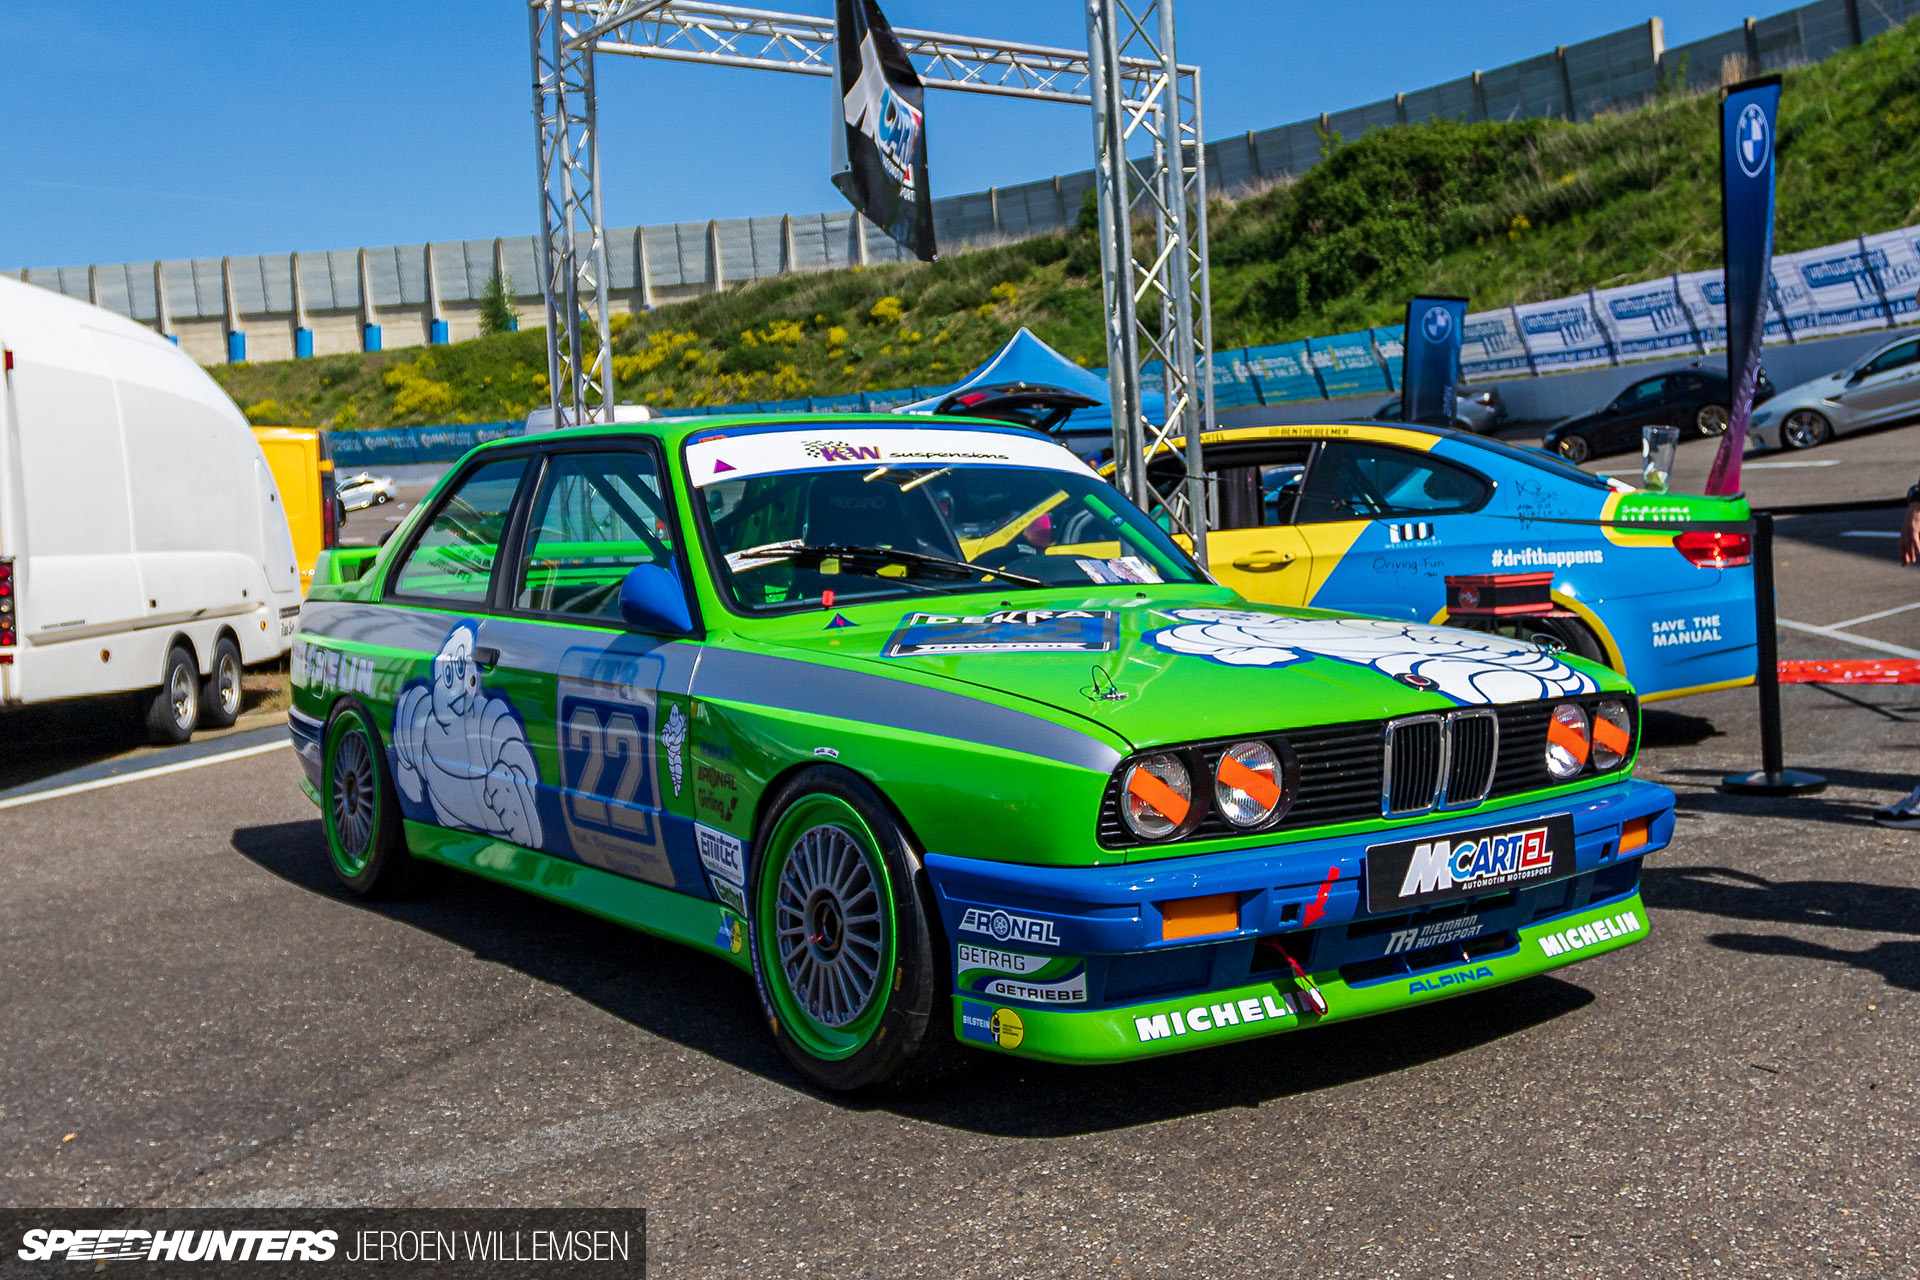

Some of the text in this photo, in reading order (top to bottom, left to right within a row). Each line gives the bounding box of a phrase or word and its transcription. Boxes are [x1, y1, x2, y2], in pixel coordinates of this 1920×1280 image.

[820, 445, 1009, 462] KW suspensions
[1492, 547, 1604, 568] #drifthappens
[925, 610, 1095, 626] DEKRA
[1652, 614, 1721, 634] SAVE THE
[1653, 627, 1723, 648] MANUAL
[568, 705, 649, 835] 22
[1507, 866, 1552, 882] MOTORSPORT
[970, 909, 1060, 946] RONAL
[1421, 914, 1478, 937] NIEMANN
[1538, 912, 1641, 958] MICHELIN
[1415, 924, 1484, 950] AUTOSPORT
[959, 945, 1025, 971] GETRAG
[1409, 966, 1493, 995] ALPINA
[995, 983, 1084, 1001] GETRIEBE
[962, 1015, 990, 1030] BILSTEIN
